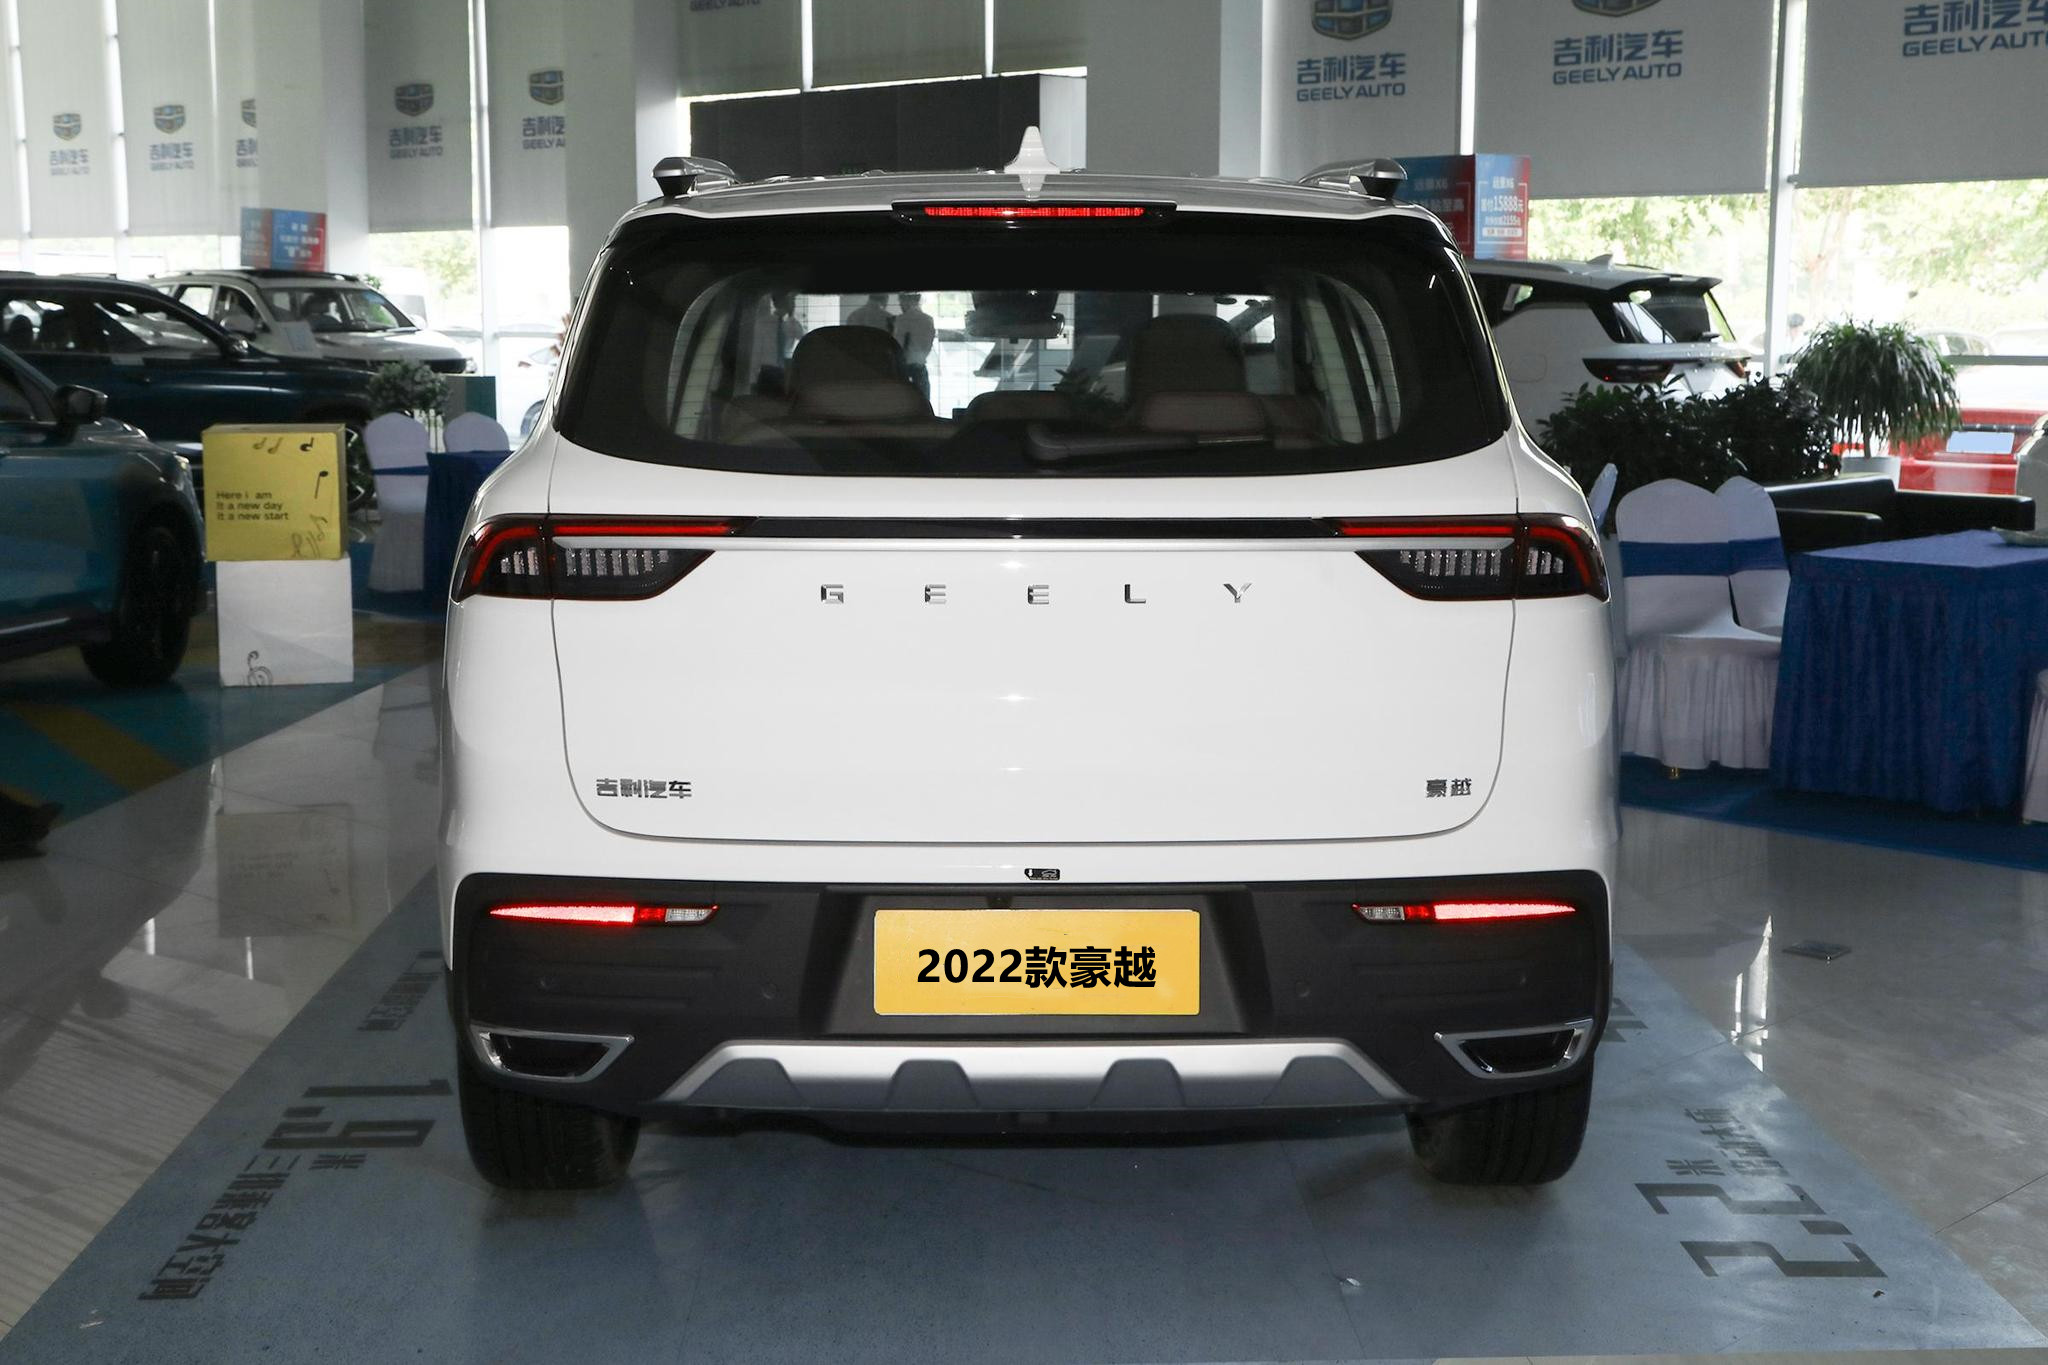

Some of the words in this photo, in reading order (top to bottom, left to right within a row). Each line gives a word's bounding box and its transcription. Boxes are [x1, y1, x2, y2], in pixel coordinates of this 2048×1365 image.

[1553, 29, 1683, 66] 吉利汽车
[1902, 35, 1988, 57] GEELY
[1990, 30, 2048, 50] AUT
[1297, 51, 1406, 85] 吉利汽车
[1553, 67, 1620, 85] GEELY
[1622, 62, 1682, 81] AUTO
[1297, 86, 1353, 102] GEELY
[1355, 82, 1406, 98] AUTO
[216, 491, 243, 499] Here
[263, 502, 283, 511] day
[263, 512, 289, 520] start
[820, 583, 1252, 605] GEELY
[596, 778, 692, 799] 吉利汽车
[1426, 778, 1472, 798] 豪越
